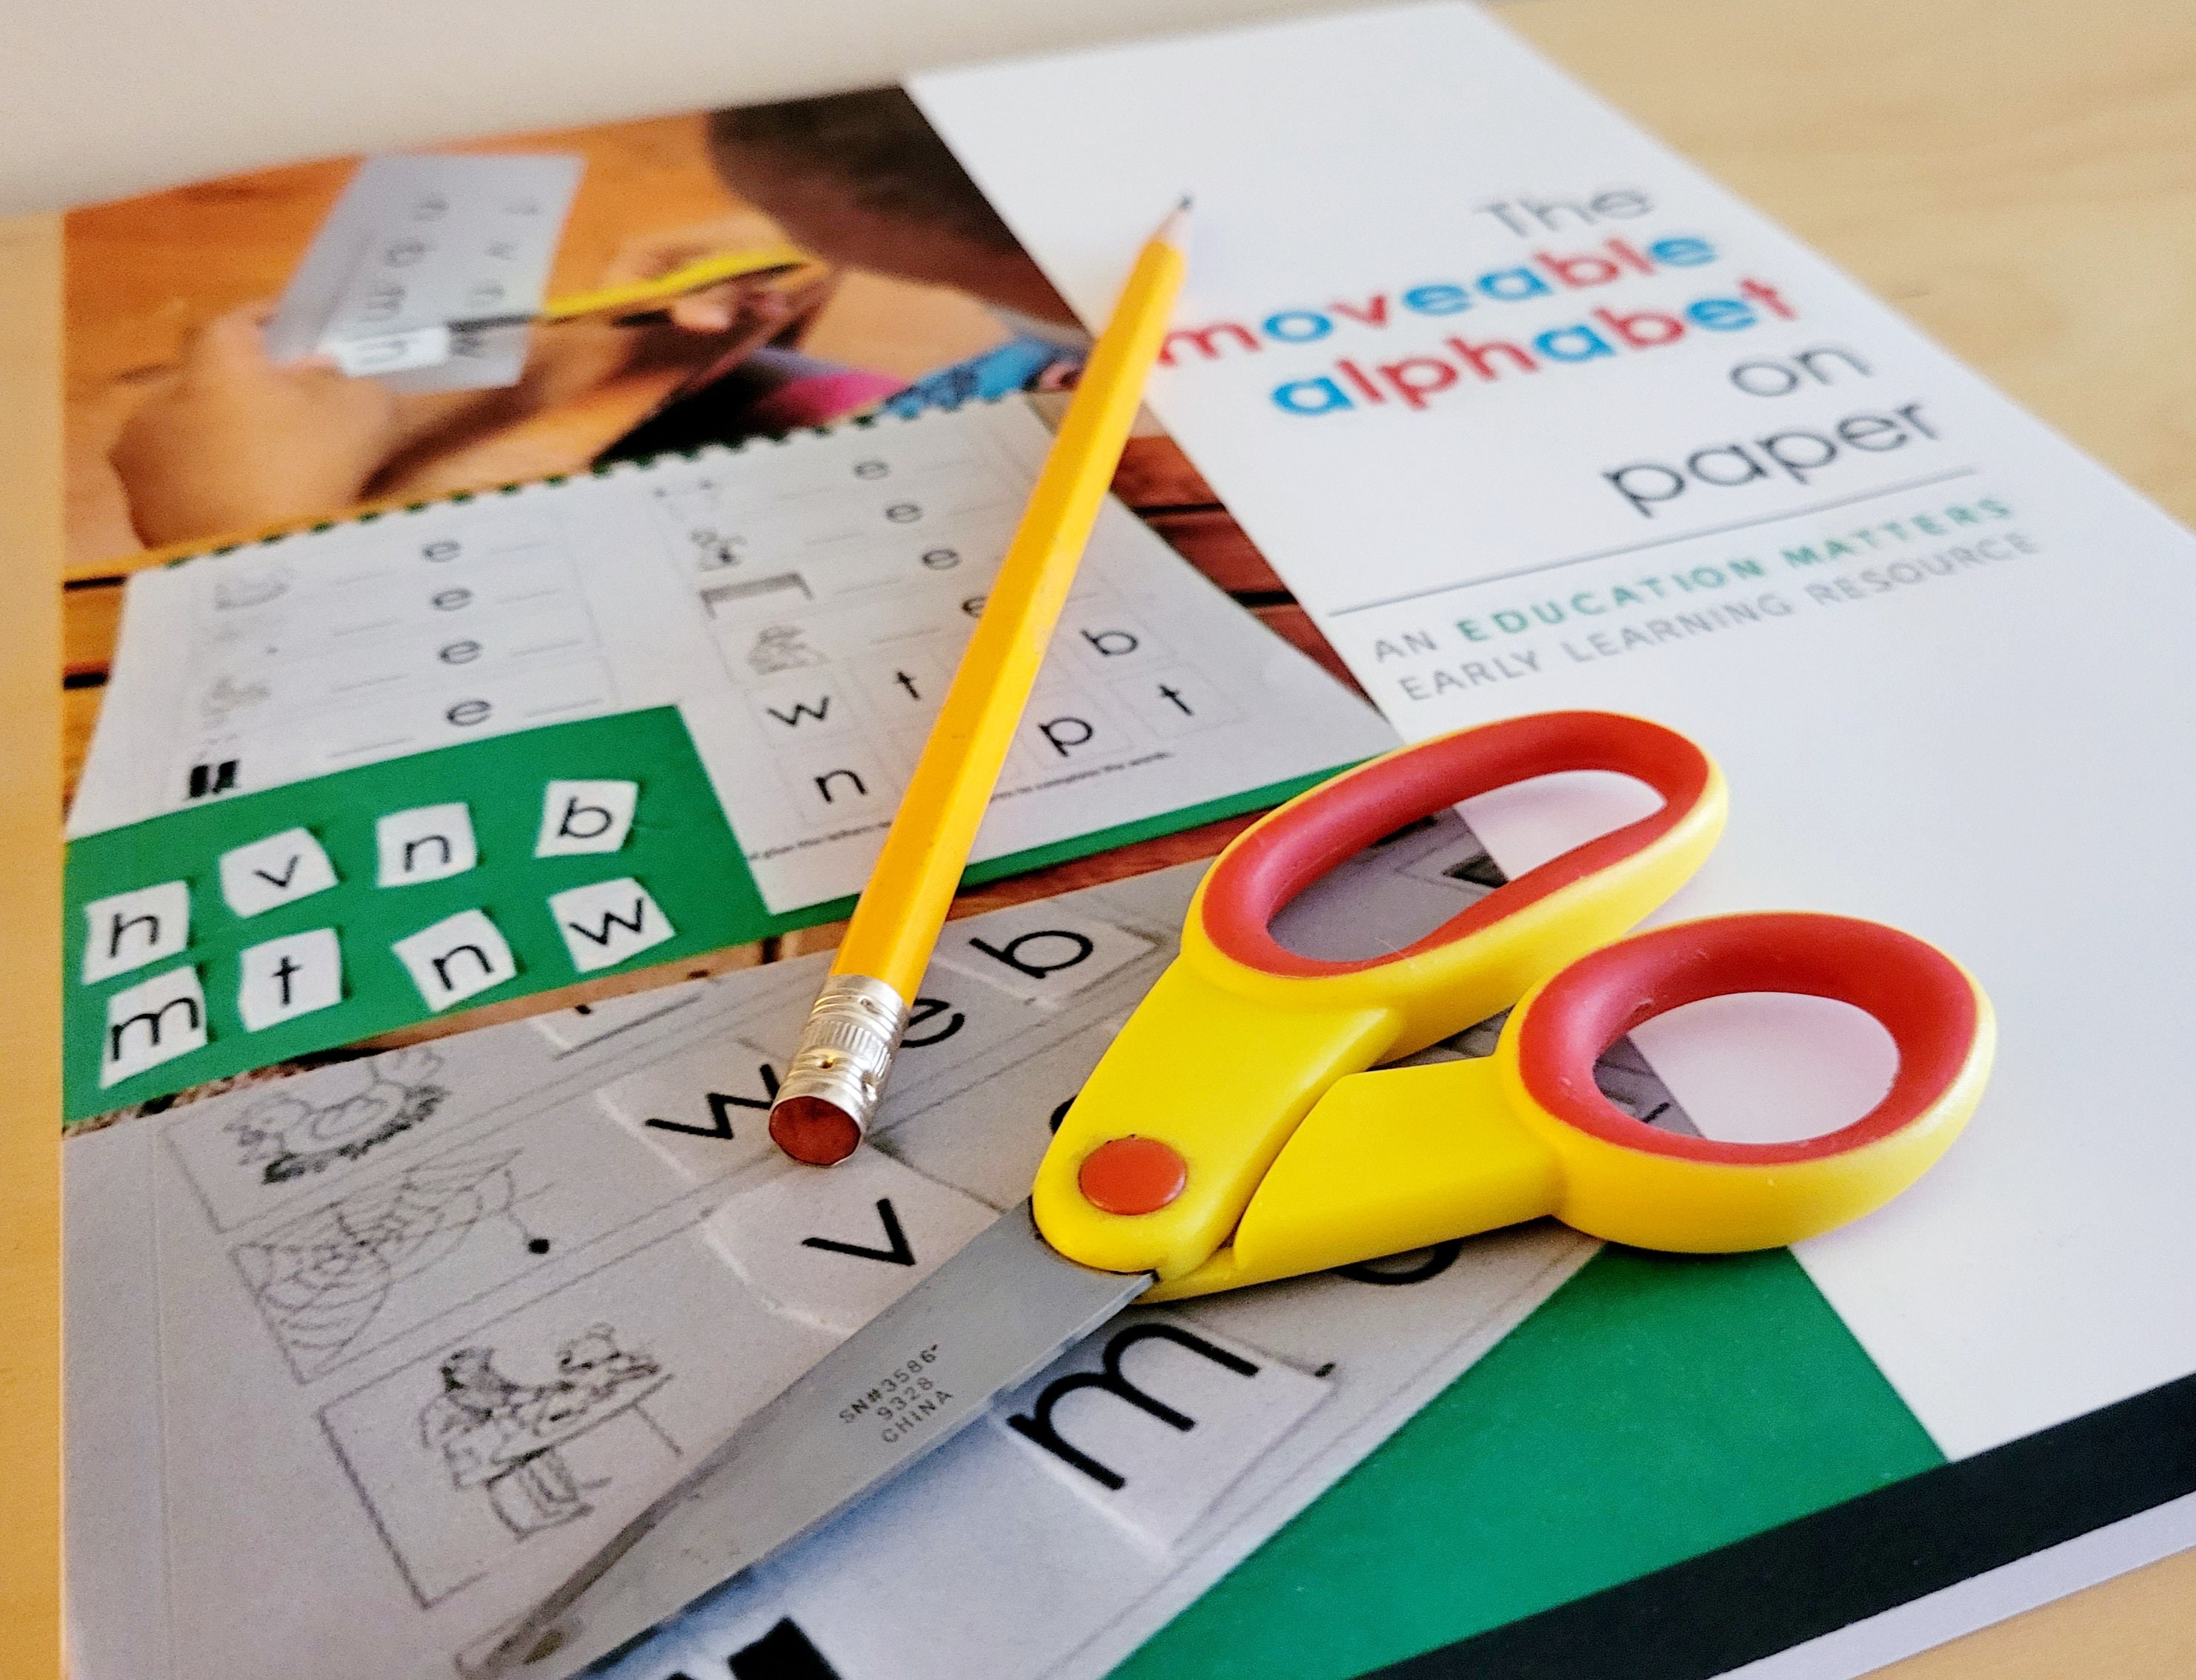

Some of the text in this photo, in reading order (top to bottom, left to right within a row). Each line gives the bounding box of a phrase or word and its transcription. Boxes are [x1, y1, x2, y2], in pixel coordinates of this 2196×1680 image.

[1473, 189, 1654, 236] The
[1157, 236, 1718, 367] moveable
[1271, 279, 1797, 416] alphabet
[1729, 346, 1873, 398] on
[1601, 401, 1941, 519] paper
[422, 539, 462, 563] e
[430, 587, 473, 611] e
[1374, 496, 2014, 664] AN EDUCATION MATTERS
[439, 639, 483, 664] e
[1398, 532, 2040, 701] EARLY LEARNING RESOURCE
[446, 699, 492, 727] e
[767, 629, 1139, 727] w t b
[815, 683, 1194, 804] n p t
[108, 796, 612, 959] h v n b
[110, 896, 645, 1062] m t n w
[969, 929, 1094, 979] b
[802, 1197, 916, 1267] v
[882, 1390, 954, 1443] CHINA
[1008, 1322, 1260, 1490] m
